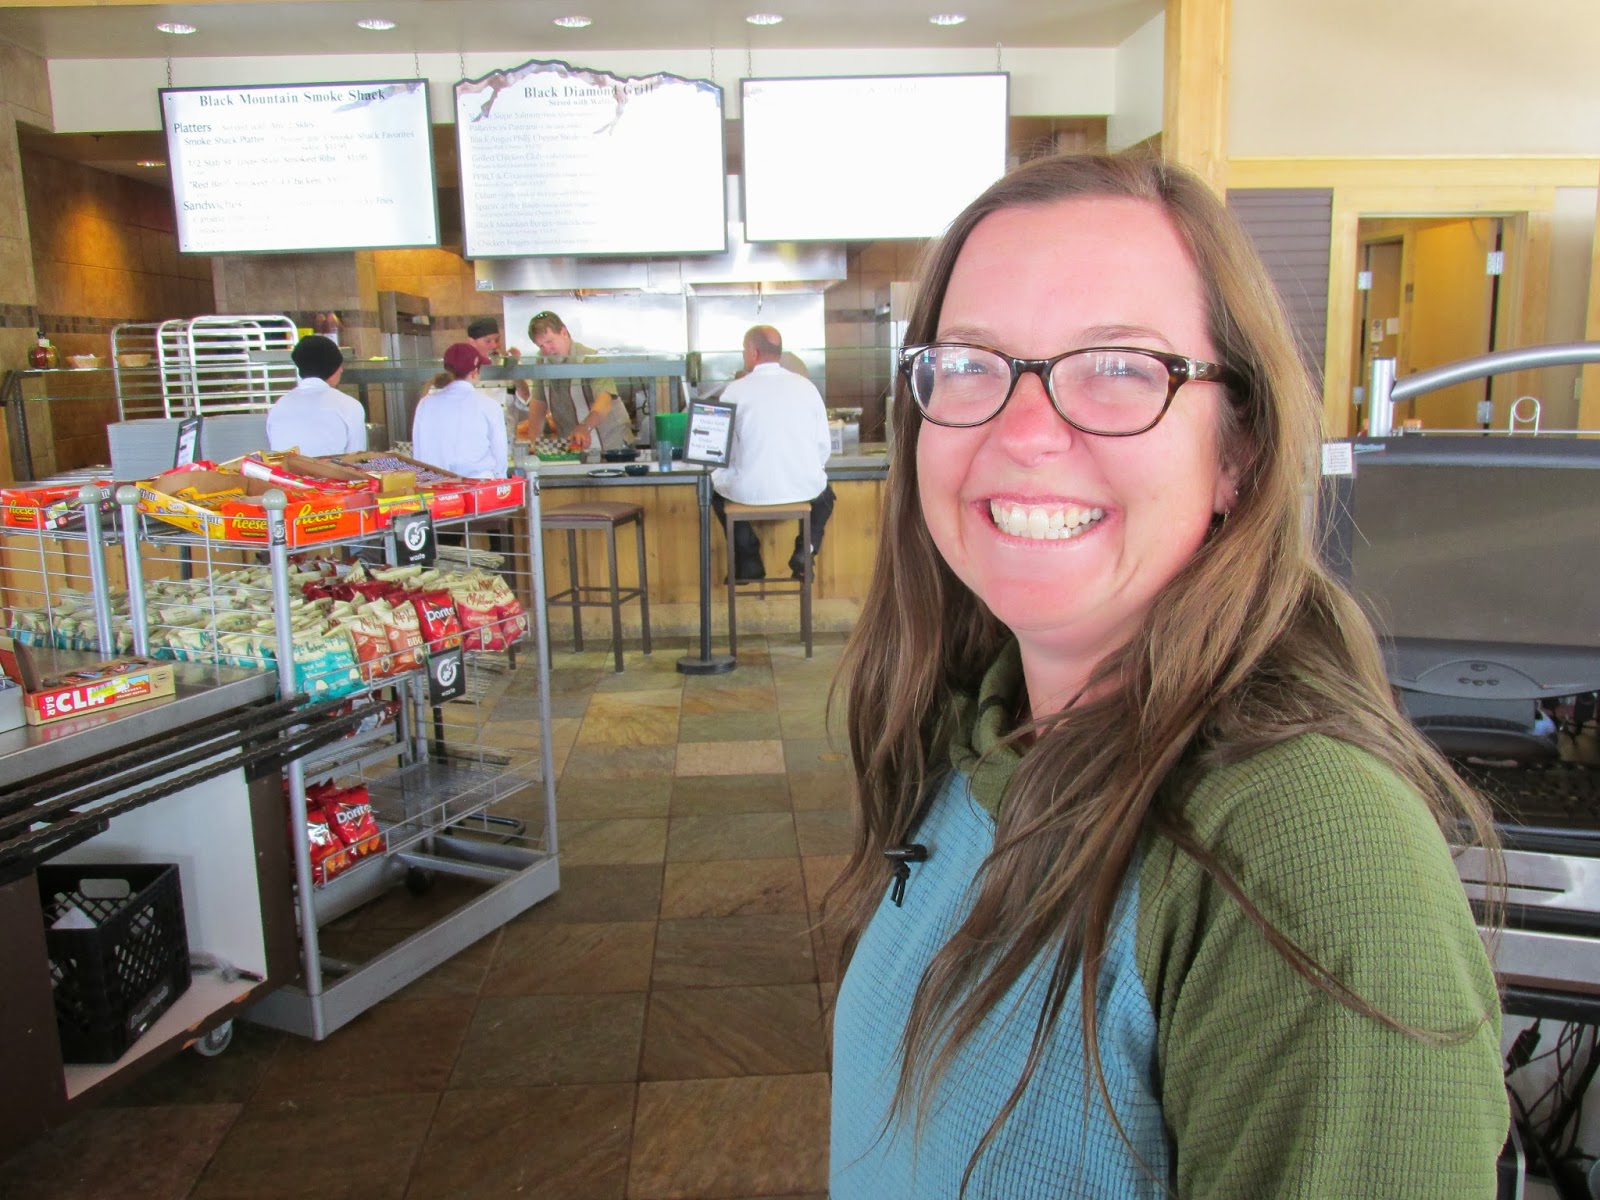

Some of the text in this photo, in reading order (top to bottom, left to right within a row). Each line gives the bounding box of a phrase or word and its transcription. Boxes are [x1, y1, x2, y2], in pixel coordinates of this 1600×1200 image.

[524, 82, 654, 98] Black Diamond Grill
[199, 88, 386, 107] Black Mountain Smoke Shack
[549, 99, 571, 107] Served
[573, 98, 589, 106] with
[173, 122, 212, 133] Platters
[184, 135, 265, 146] Smoke Shack Platter
[358, 131, 381, 140] Shack
[381, 130, 416, 140] Favorites
[319, 153, 337, 162] Ribs
[295, 503, 343, 527] Reese's
[409, 552, 426, 562] waste
[441, 687, 456, 698] waste
[45, 696, 55, 717] BAR
